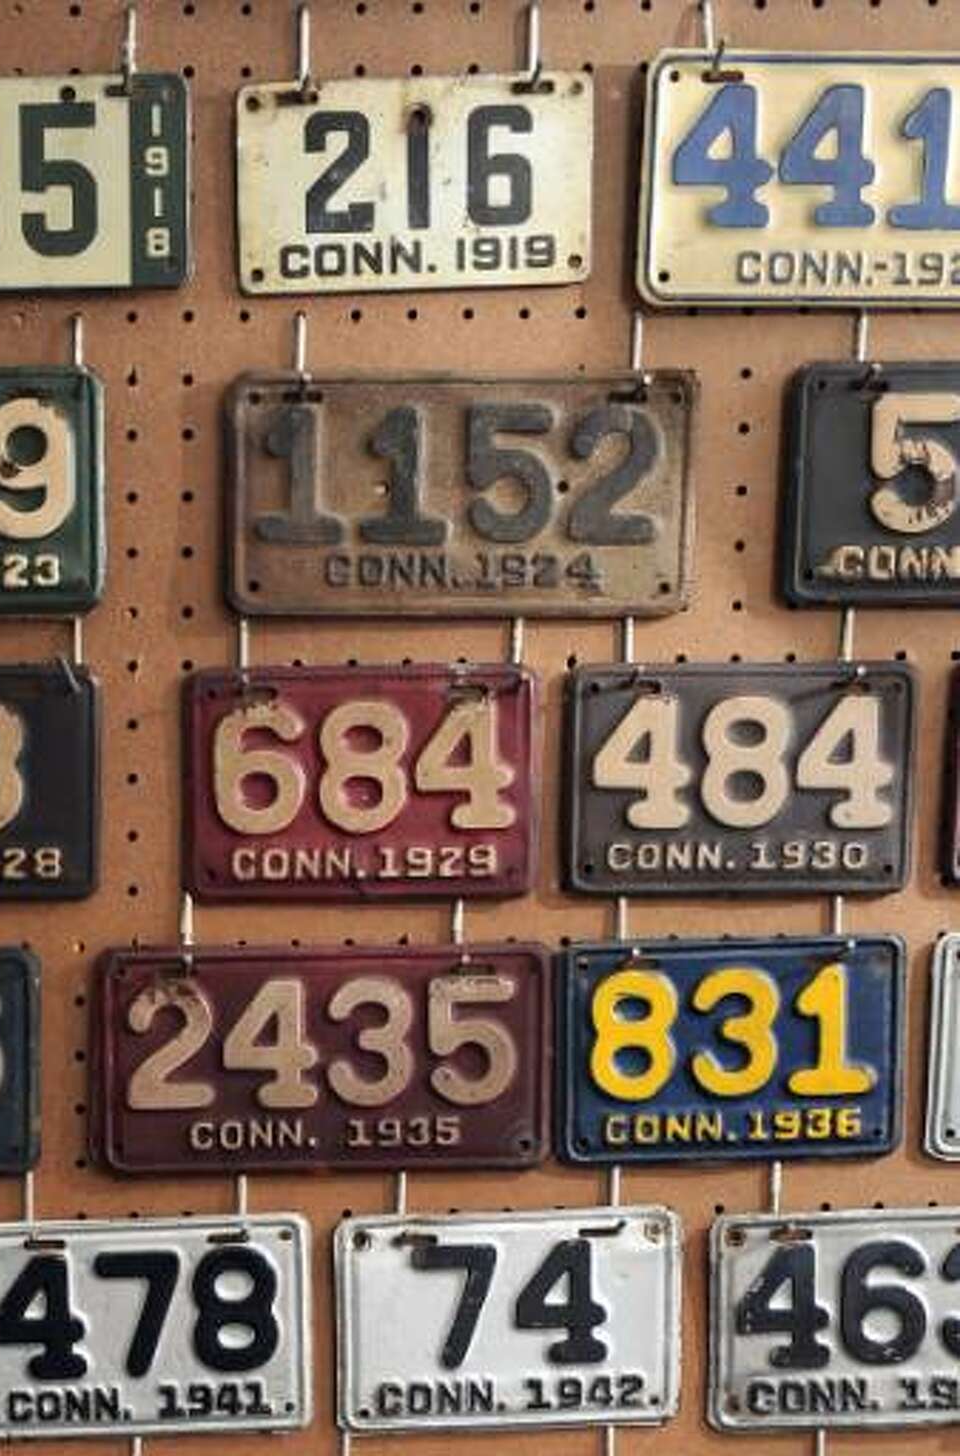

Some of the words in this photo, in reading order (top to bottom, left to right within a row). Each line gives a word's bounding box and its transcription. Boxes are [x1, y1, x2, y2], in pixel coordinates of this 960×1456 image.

[144, 103, 172, 259] 1918
[303, 104, 534, 234] 216
[279, 238, 438, 280] CONN.
[455, 235, 556, 272] 1919
[253, 403, 658, 547] 1152
[872, 392, 960, 533] 5
[214, 699, 516, 834] 684
[592, 695, 892, 829] 484
[127, 975, 518, 1109] 2435
[589, 964, 876, 1101] 831
[190, 1120, 317, 1151] CONN.
[348, 1118, 460, 1145] 1935
[410, 1238, 608, 1369] 74
[735, 1243, 960, 1369] 46
[6, 1387, 132, 1422] CONN.
[157, 1383, 272, 1416] 1941
[376, 1381, 505, 1416] CONN.
[526, 1376, 645, 1410] 1942
[746, 1378, 879, 1415] CONN.
